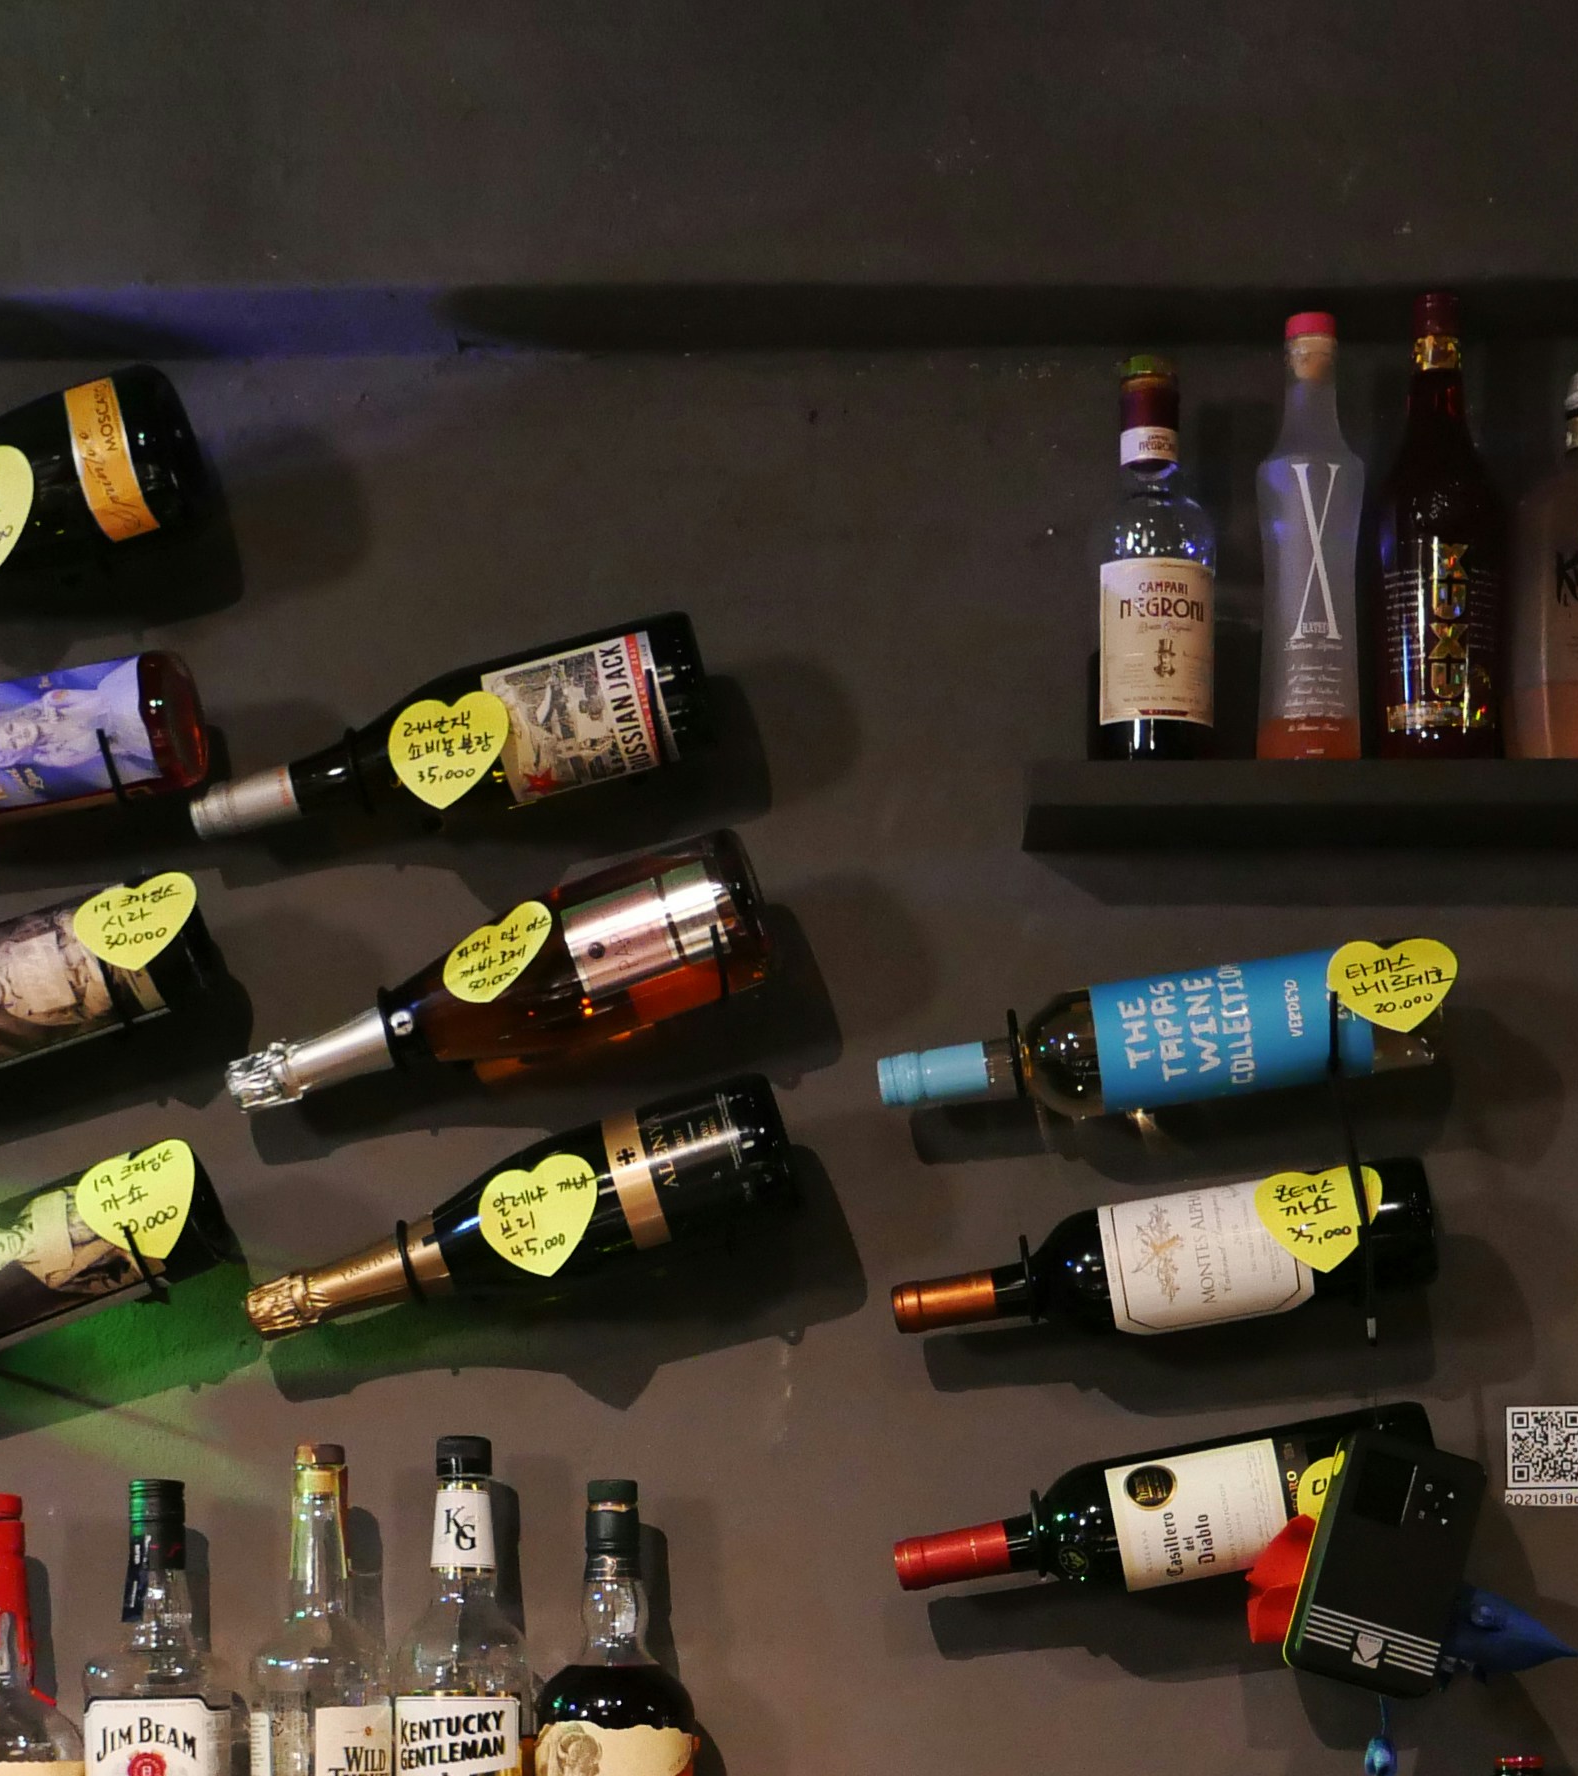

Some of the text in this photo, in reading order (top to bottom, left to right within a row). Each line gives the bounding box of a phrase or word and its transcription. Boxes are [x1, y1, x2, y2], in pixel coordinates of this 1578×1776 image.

[1291, 462, 1344, 640] X
[1139, 581, 1189, 595] CAMPARI
[1120, 598, 1205, 622] NEGRONI
[598, 642, 634, 693] JACK
[105, 927, 168, 950] 30,000
[1344, 952, 1416, 981] 타파스
[1116, 997, 1156, 1070] THE
[1149, 981, 1188, 1083] TAPAS
[1180, 976, 1222, 1073] WINE
[1217, 963, 1256, 1085] COLLECTION
[93, 1174, 114, 1193] 19
[511, 1232, 566, 1258] 45,000
[1193, 1235, 1218, 1304] MONTES
[1162, 1511, 1185, 1579] Casillero
[1184, 1535, 1196, 1552] del
[1195, 1513, 1217, 1566] Diablo
[96, 1716, 197, 1763] JIM BEAM
[400, 1710, 506, 1746] KENTUCKY
[343, 1746, 387, 1772] WILD
[400, 1735, 506, 1771] GENTLEMAN
